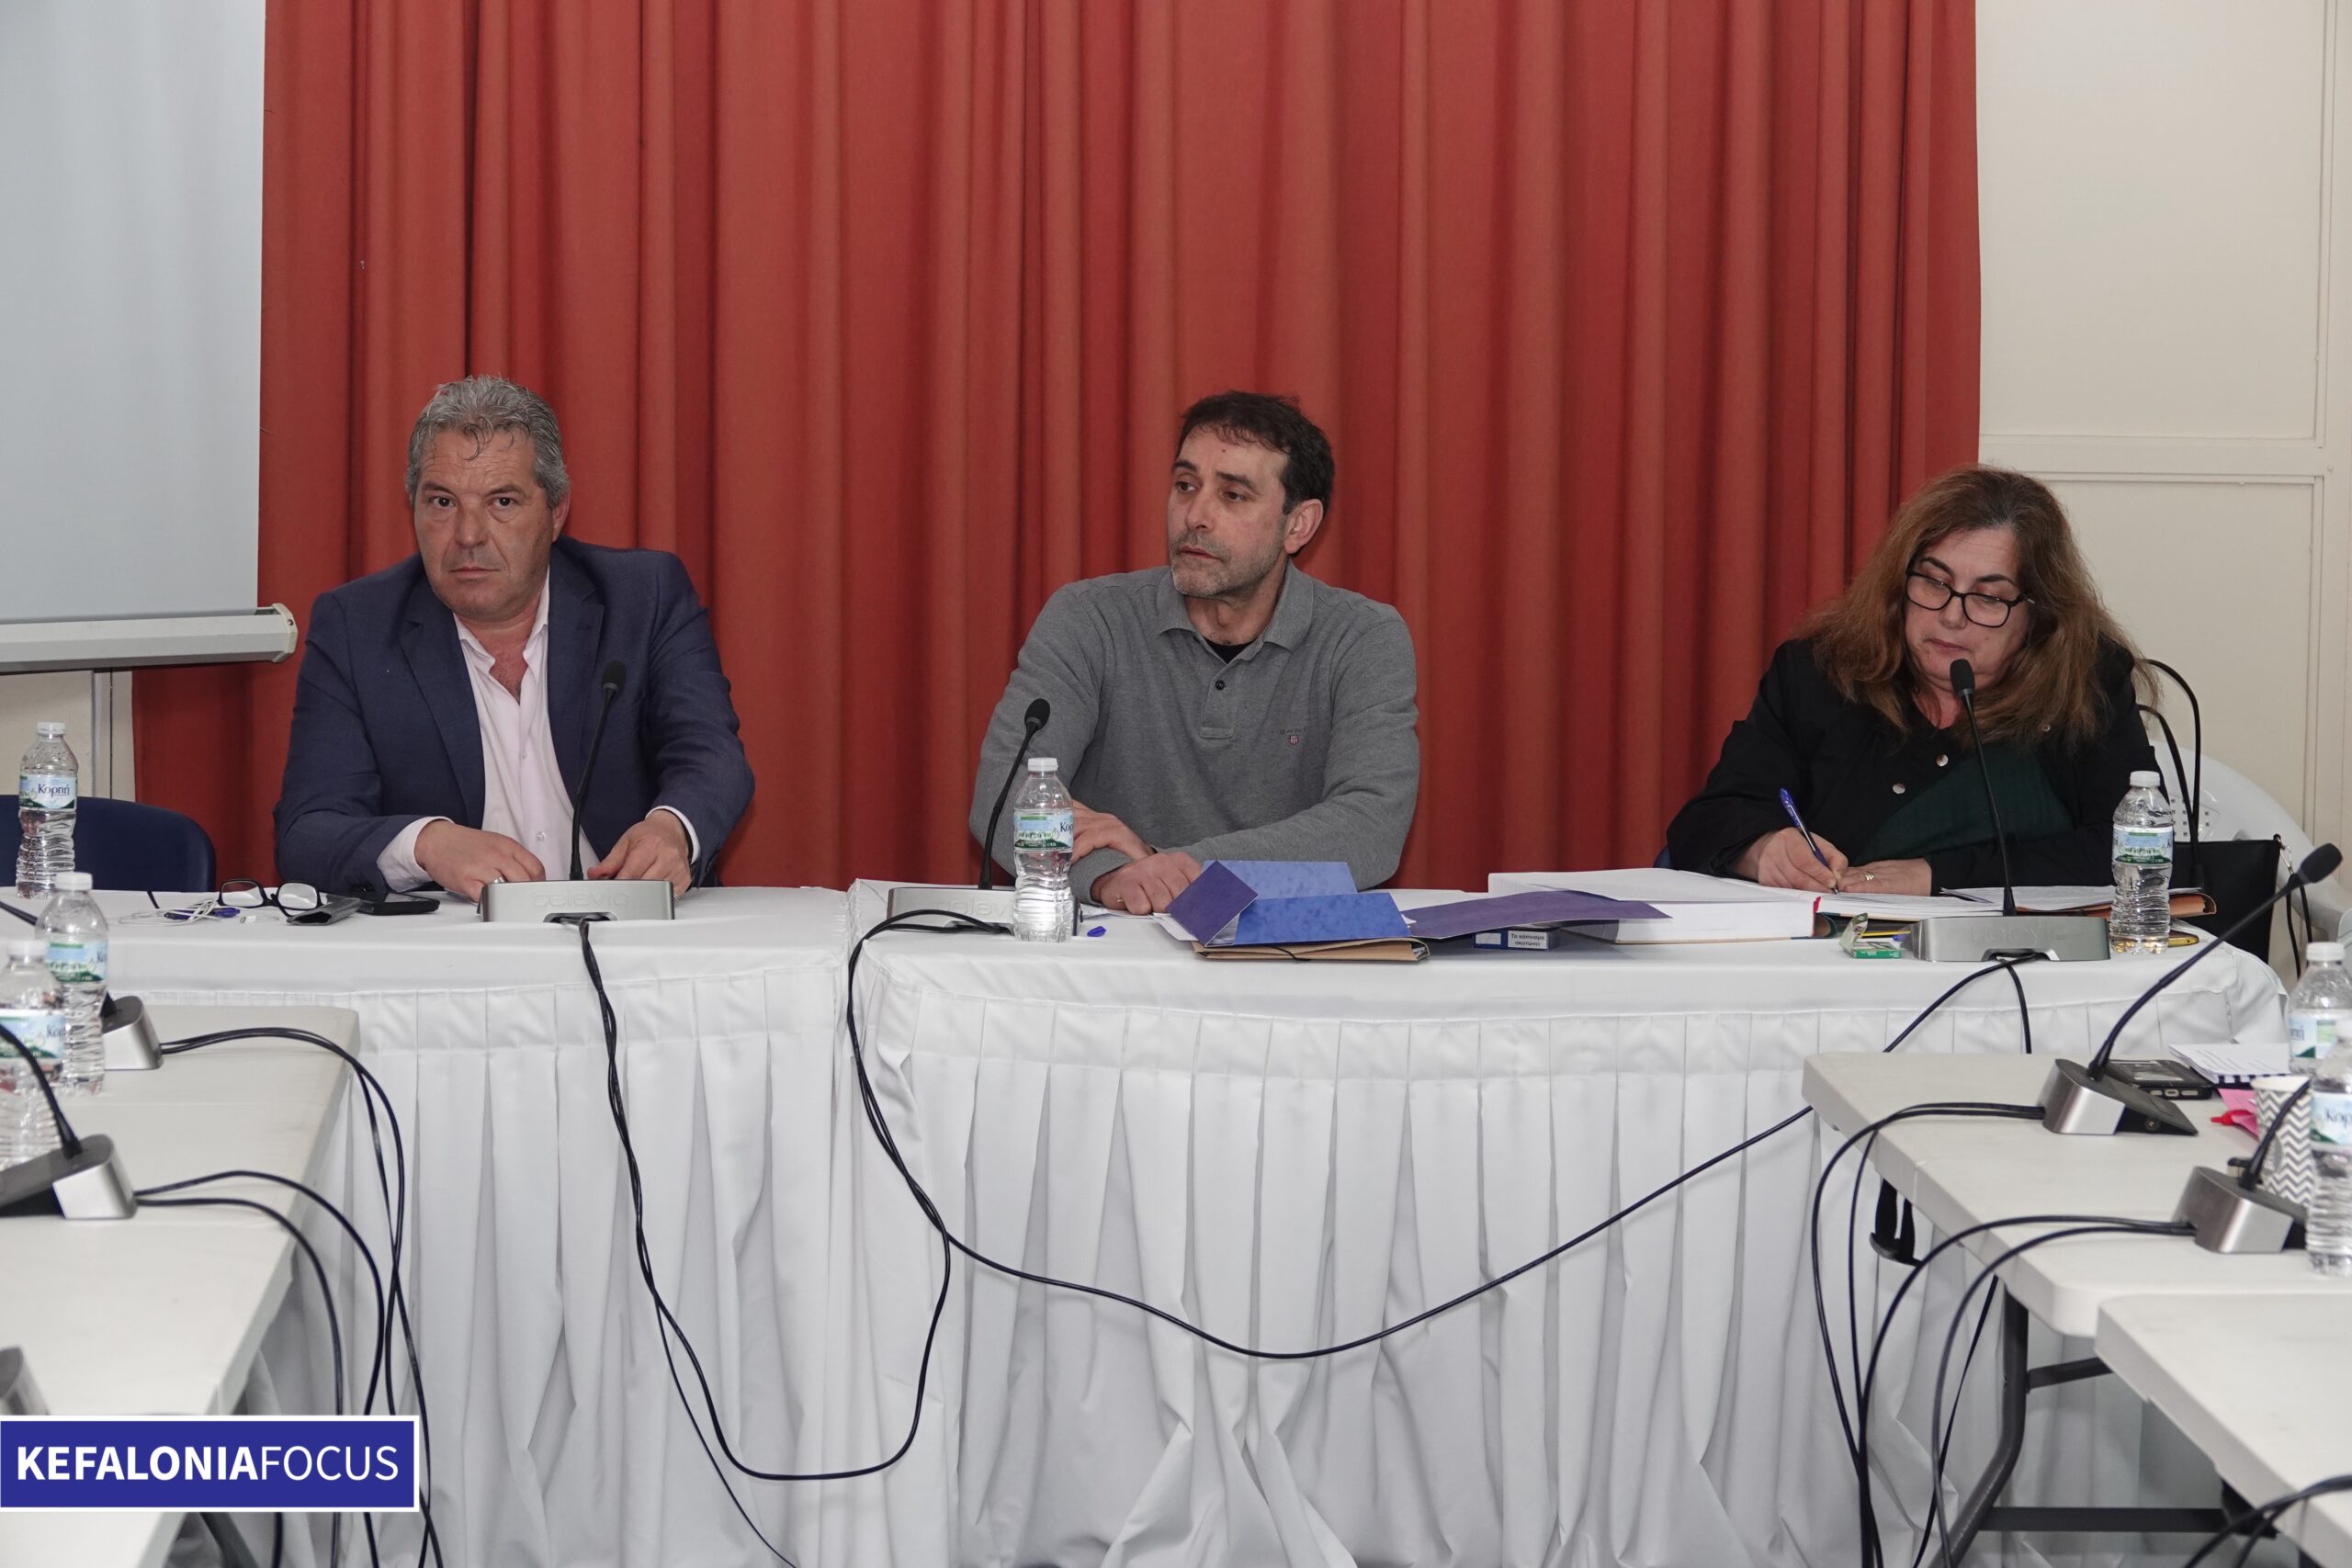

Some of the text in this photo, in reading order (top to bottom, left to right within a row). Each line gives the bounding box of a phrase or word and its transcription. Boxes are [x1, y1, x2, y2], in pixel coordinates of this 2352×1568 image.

[38, 783, 70, 798] Κορπή
[1059, 821, 1074, 835] Κορ
[2324, 1107, 2352, 1129] Κορ
